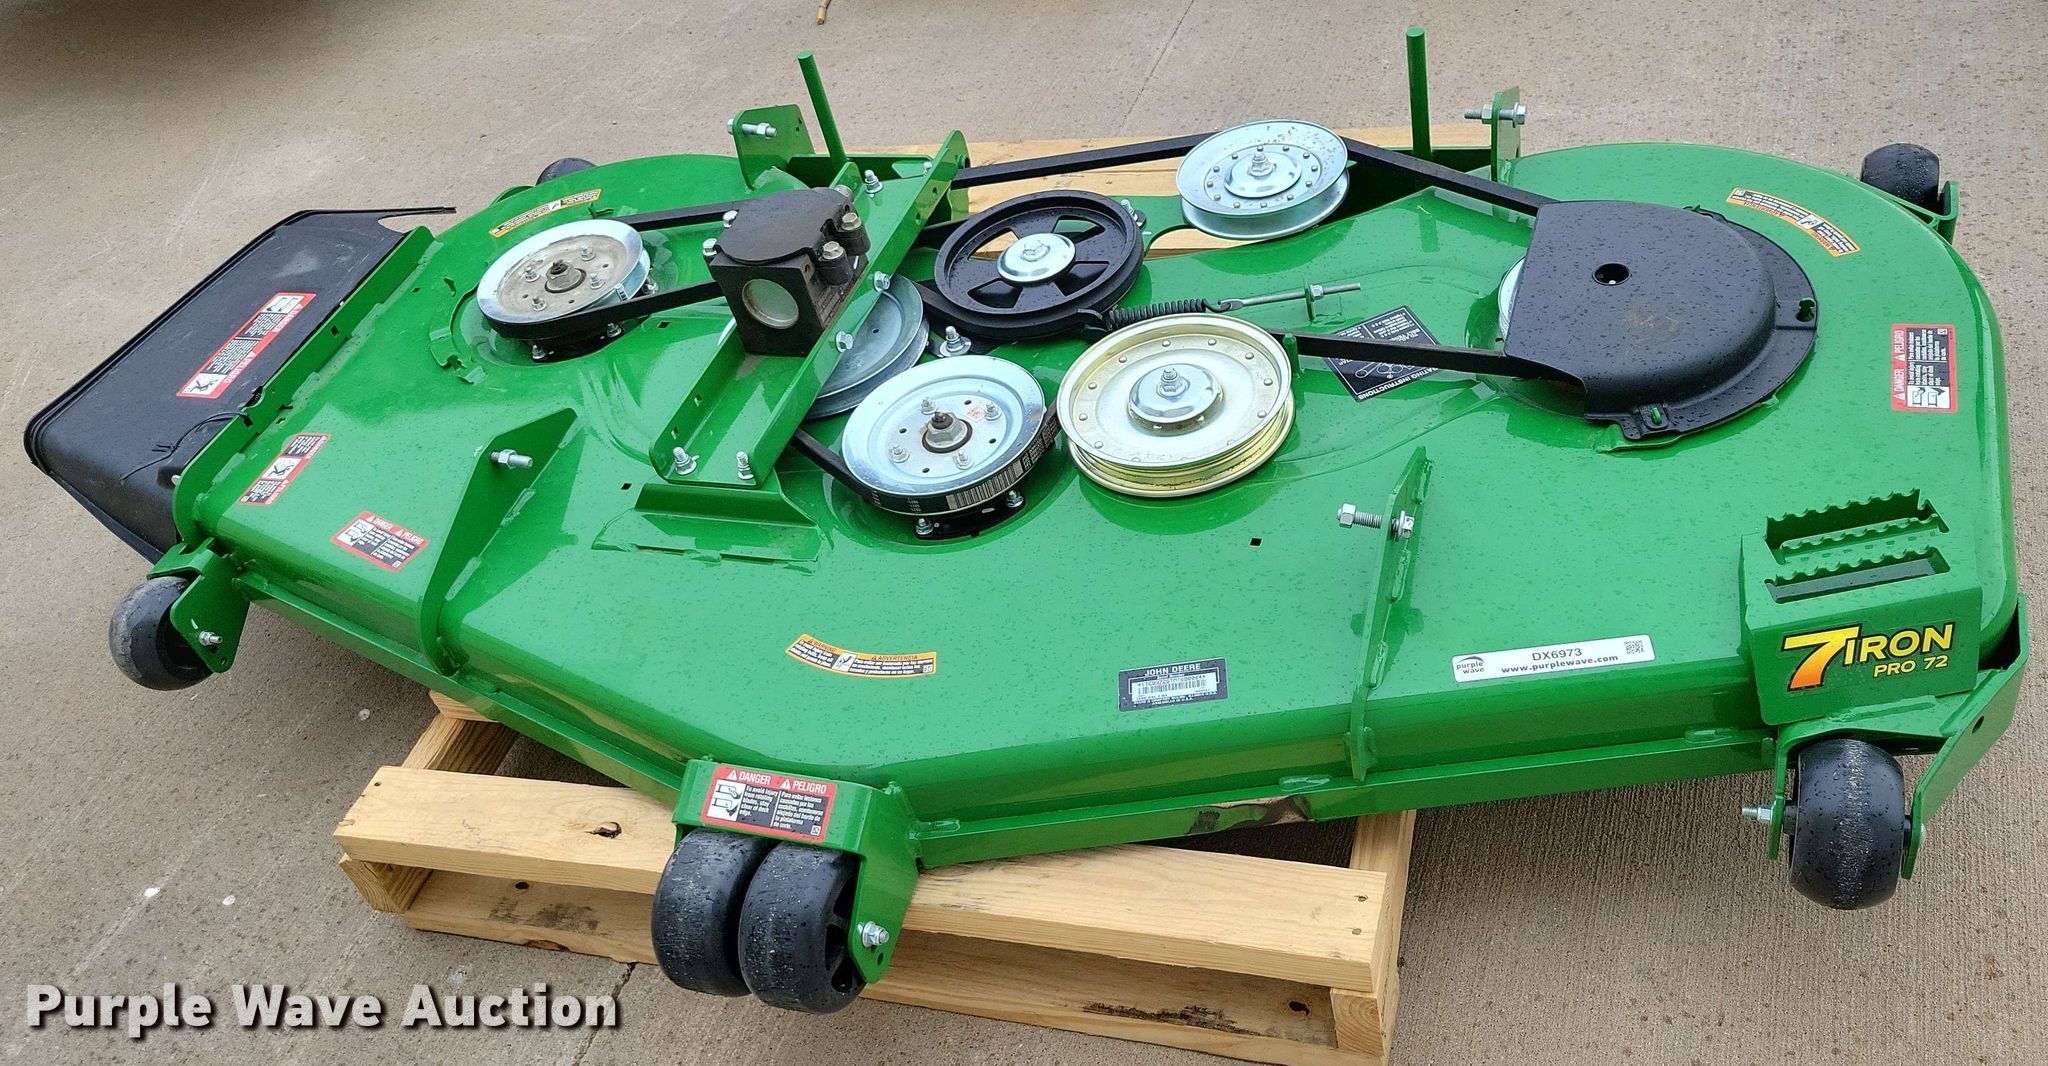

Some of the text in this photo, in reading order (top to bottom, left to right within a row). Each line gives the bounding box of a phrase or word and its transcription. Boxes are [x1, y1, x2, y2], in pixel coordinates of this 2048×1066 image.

[1894, 330, 1903, 391] DANGER PELIGRO
[1358, 377, 1411, 399] INSTRUCTIONS
[1532, 648, 1582, 661] DX6973
[1145, 667, 1169, 676] JOHN
[1172, 663, 1201, 672] DEERE
[1456, 661, 1483, 671] purple
[1462, 667, 1485, 675] wave
[1501, 655, 1618, 674] www.purplewave.com
[1873, 655, 1948, 678] PRO 72
[738, 772, 827, 794] DANGER PELIGRO
